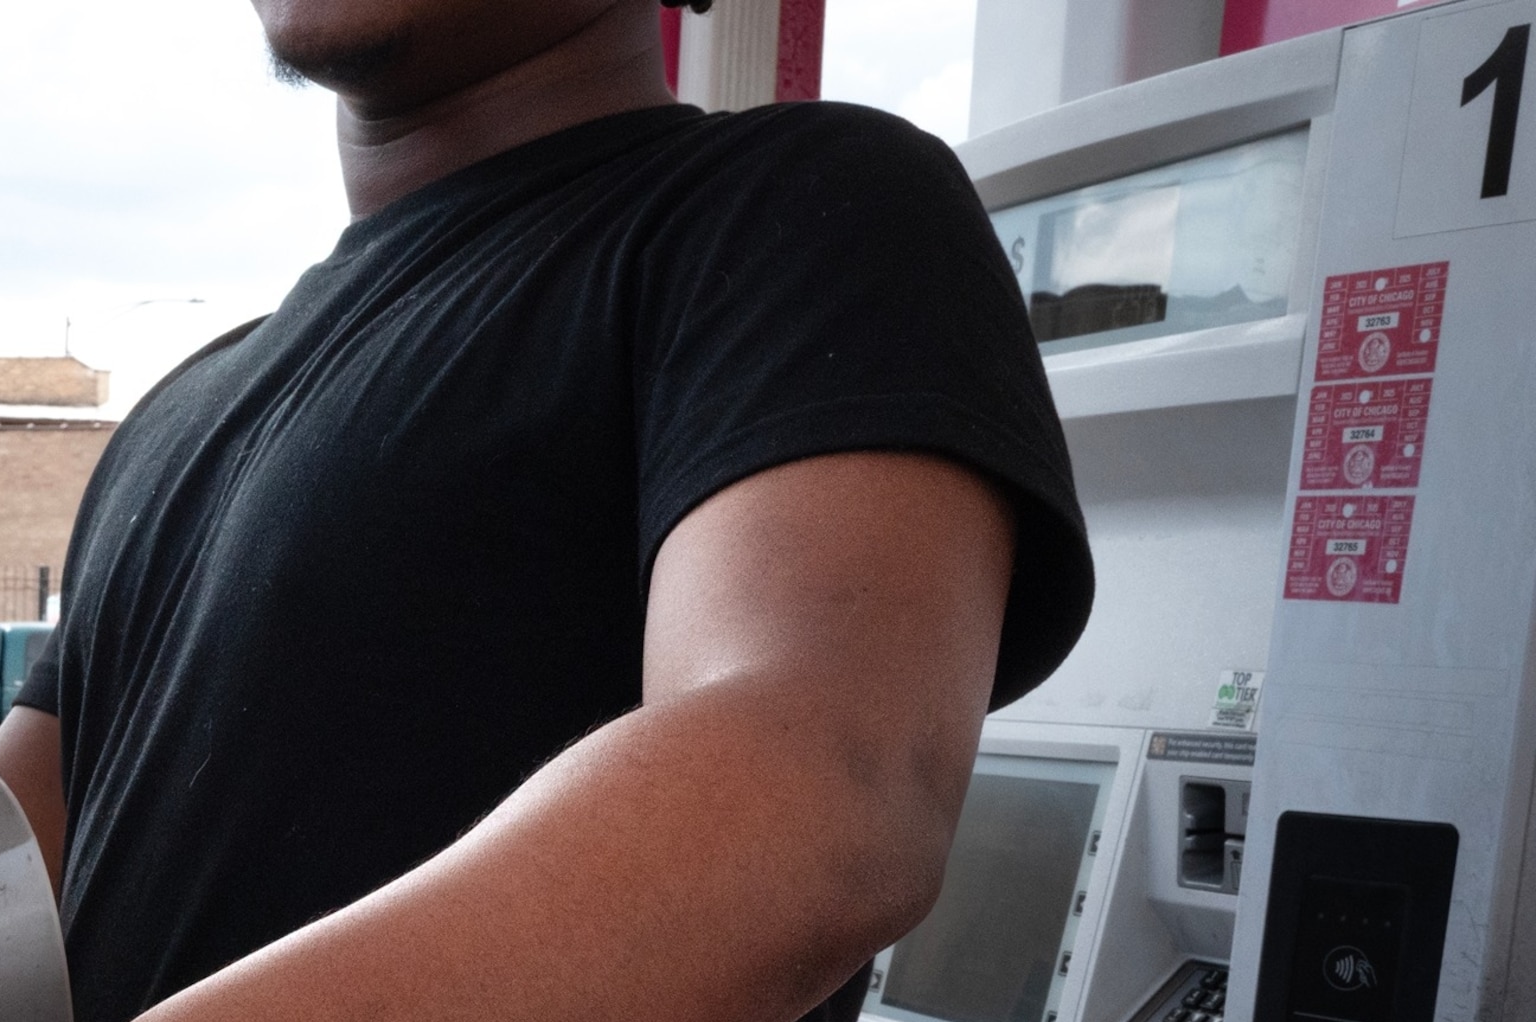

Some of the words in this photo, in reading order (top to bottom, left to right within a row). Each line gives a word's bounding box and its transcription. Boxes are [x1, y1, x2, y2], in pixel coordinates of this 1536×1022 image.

[1460, 23, 1531, 199] 1
[1349, 296, 1366, 307] CITY
[1368, 295, 1377, 305] OF
[1379, 290, 1414, 303] CHICAGO
[1365, 316, 1391, 328] 32763
[1334, 408, 1351, 418] CITY
[1352, 407, 1362, 417] OF
[1365, 405, 1398, 416] CHICAGO
[1350, 429, 1375, 440] 32764
[1318, 520, 1335, 529] CITY
[1336, 520, 1346, 529] OF
[1347, 520, 1381, 529] CHICAGO
[1334, 542, 1358, 552] 32765
[1233, 672, 1252, 686] TOP
[1236, 687, 1258, 701] TIER
